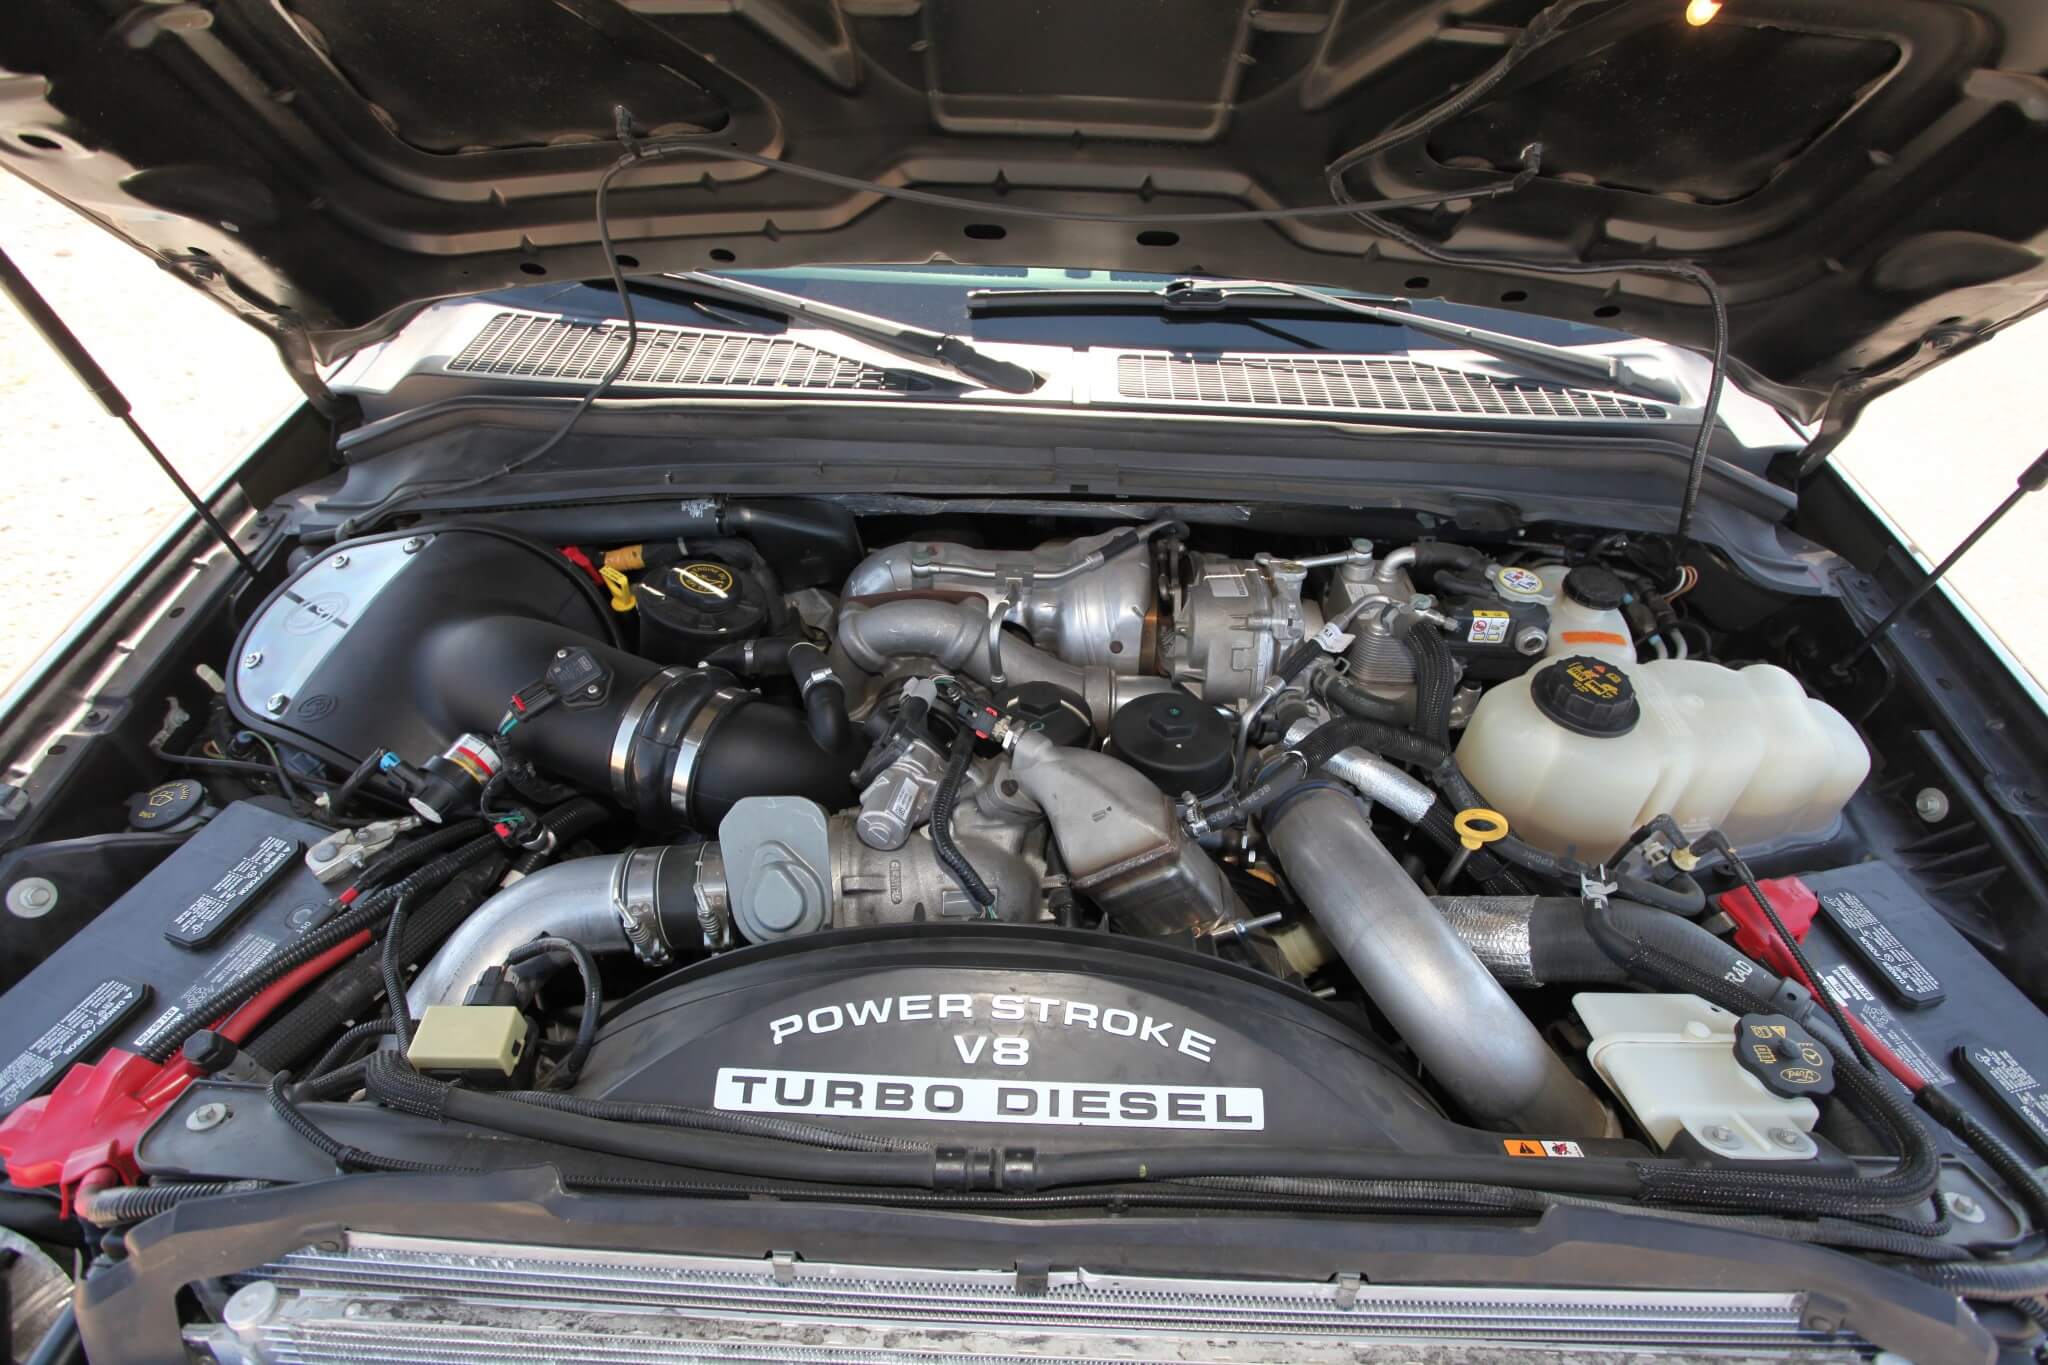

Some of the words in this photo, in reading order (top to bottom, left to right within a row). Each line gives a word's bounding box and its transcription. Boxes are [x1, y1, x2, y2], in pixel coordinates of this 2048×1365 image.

[770, 994, 973, 1045] POWER
[991, 995, 1216, 1063] STROKE
[953, 1035, 1029, 1066] V8
[731, 1075, 964, 1114] TURBO
[997, 1087, 1253, 1124] DIESEL
